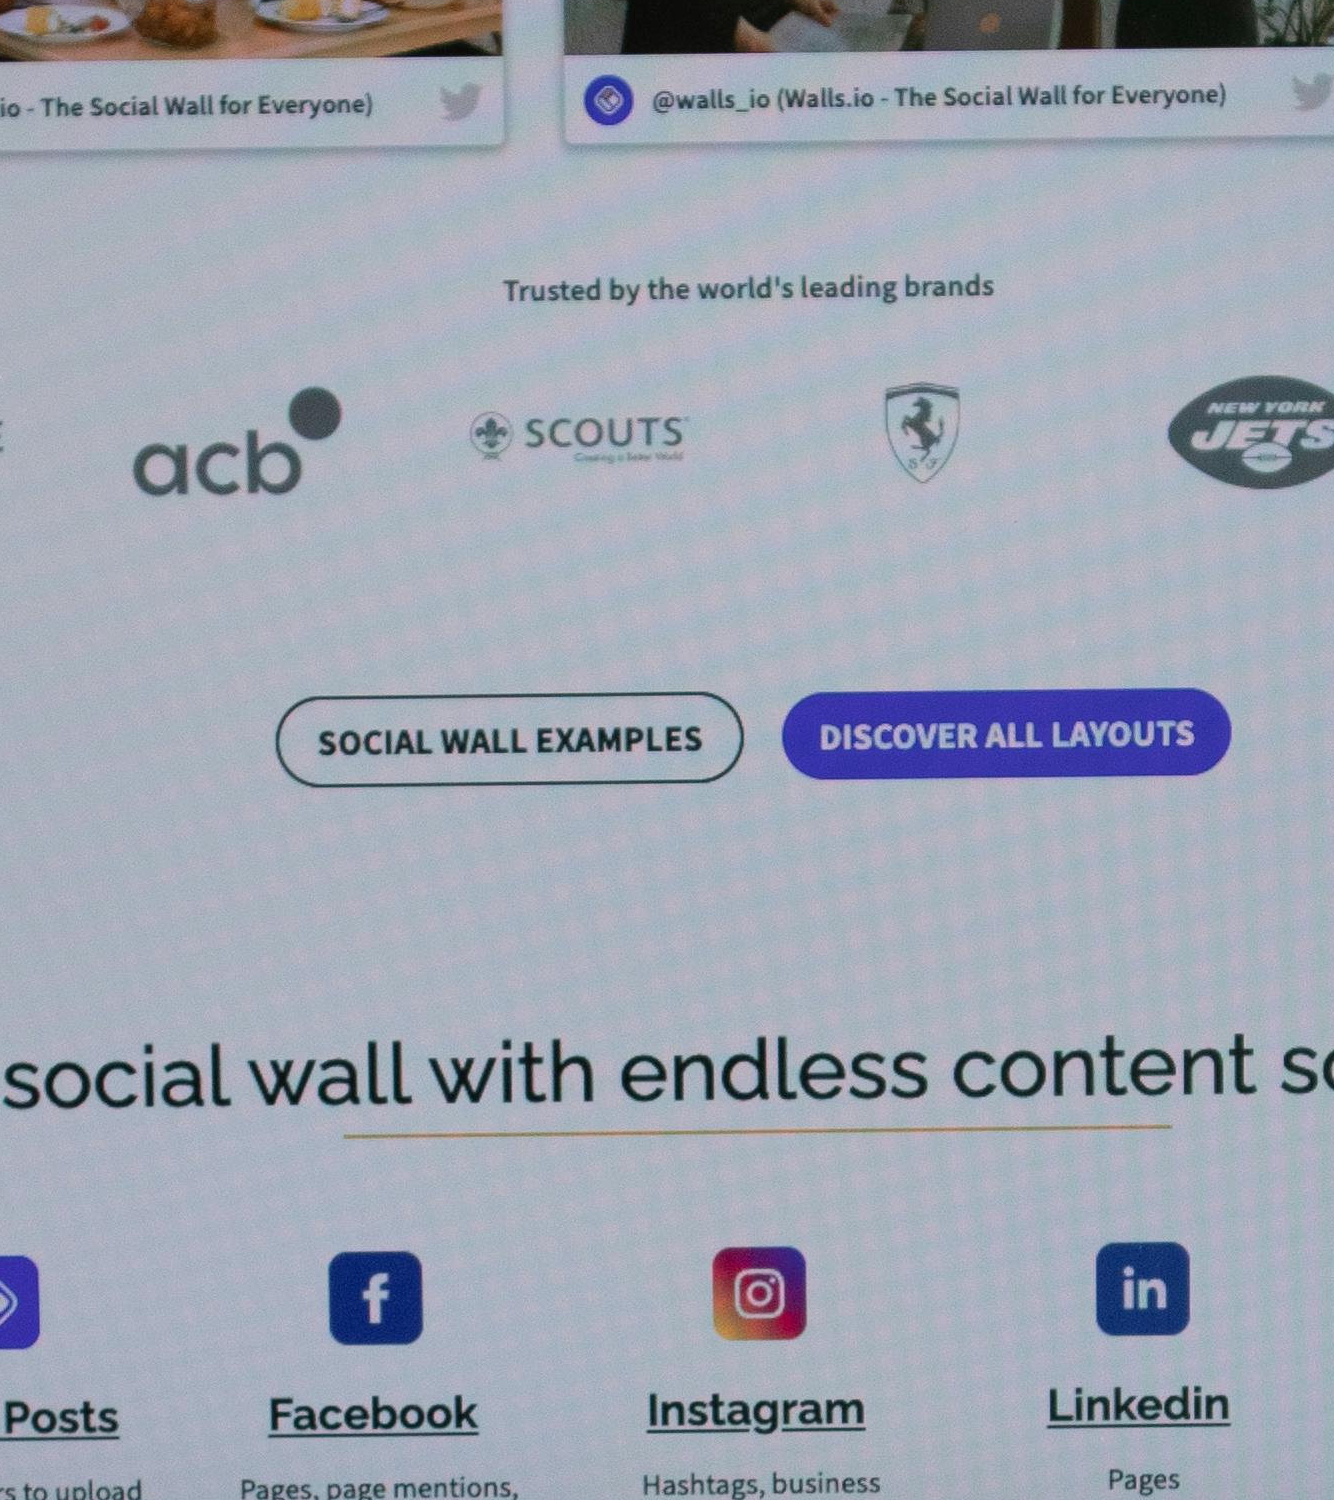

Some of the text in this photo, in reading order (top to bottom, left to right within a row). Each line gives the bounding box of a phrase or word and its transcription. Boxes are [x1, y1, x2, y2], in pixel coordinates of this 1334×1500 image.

[40, 96, 84, 118] The
[89, 95, 159, 118] Social
[163, 95, 214, 117] Wall
[218, 93, 253, 116] for
[257, 93, 373, 119] Everyone)
[652, 89, 771, 115] @walls_io
[776, 86, 875, 112] (Walls.io
[894, 85, 938, 107] The
[943, 85, 1013, 107] Social
[1017, 84, 1068, 107] Wall
[1071, 83, 1106, 105] for
[1111, 83, 1227, 110] Everyone)
[503, 272, 995, 307] Trusted by the world's leading brands
[1207, 400, 1326, 415] NEW YORK
[525, 416, 684, 449] SCOUTS
[132, 425, 304, 497] acb
[318, 725, 703, 756] SOCIAL WALL EXAMPLES
[820, 719, 1195, 751] DISCOVER ALL LAYOUTS
[3, 1041, 232, 1111] social
[247, 1039, 413, 1106] wall
[428, 1037, 594, 1104] with
[620, 1034, 928, 1102] endless
[953, 1032, 1257, 1099] content
[4, 1399, 119, 1435] Posts
[270, 1394, 478, 1432] Facebook
[648, 1392, 865, 1434] Instagram
[1049, 1384, 1230, 1422] Linkedin
[771, 1470, 882, 1495] business
[1108, 1467, 1181, 1498] Pages
